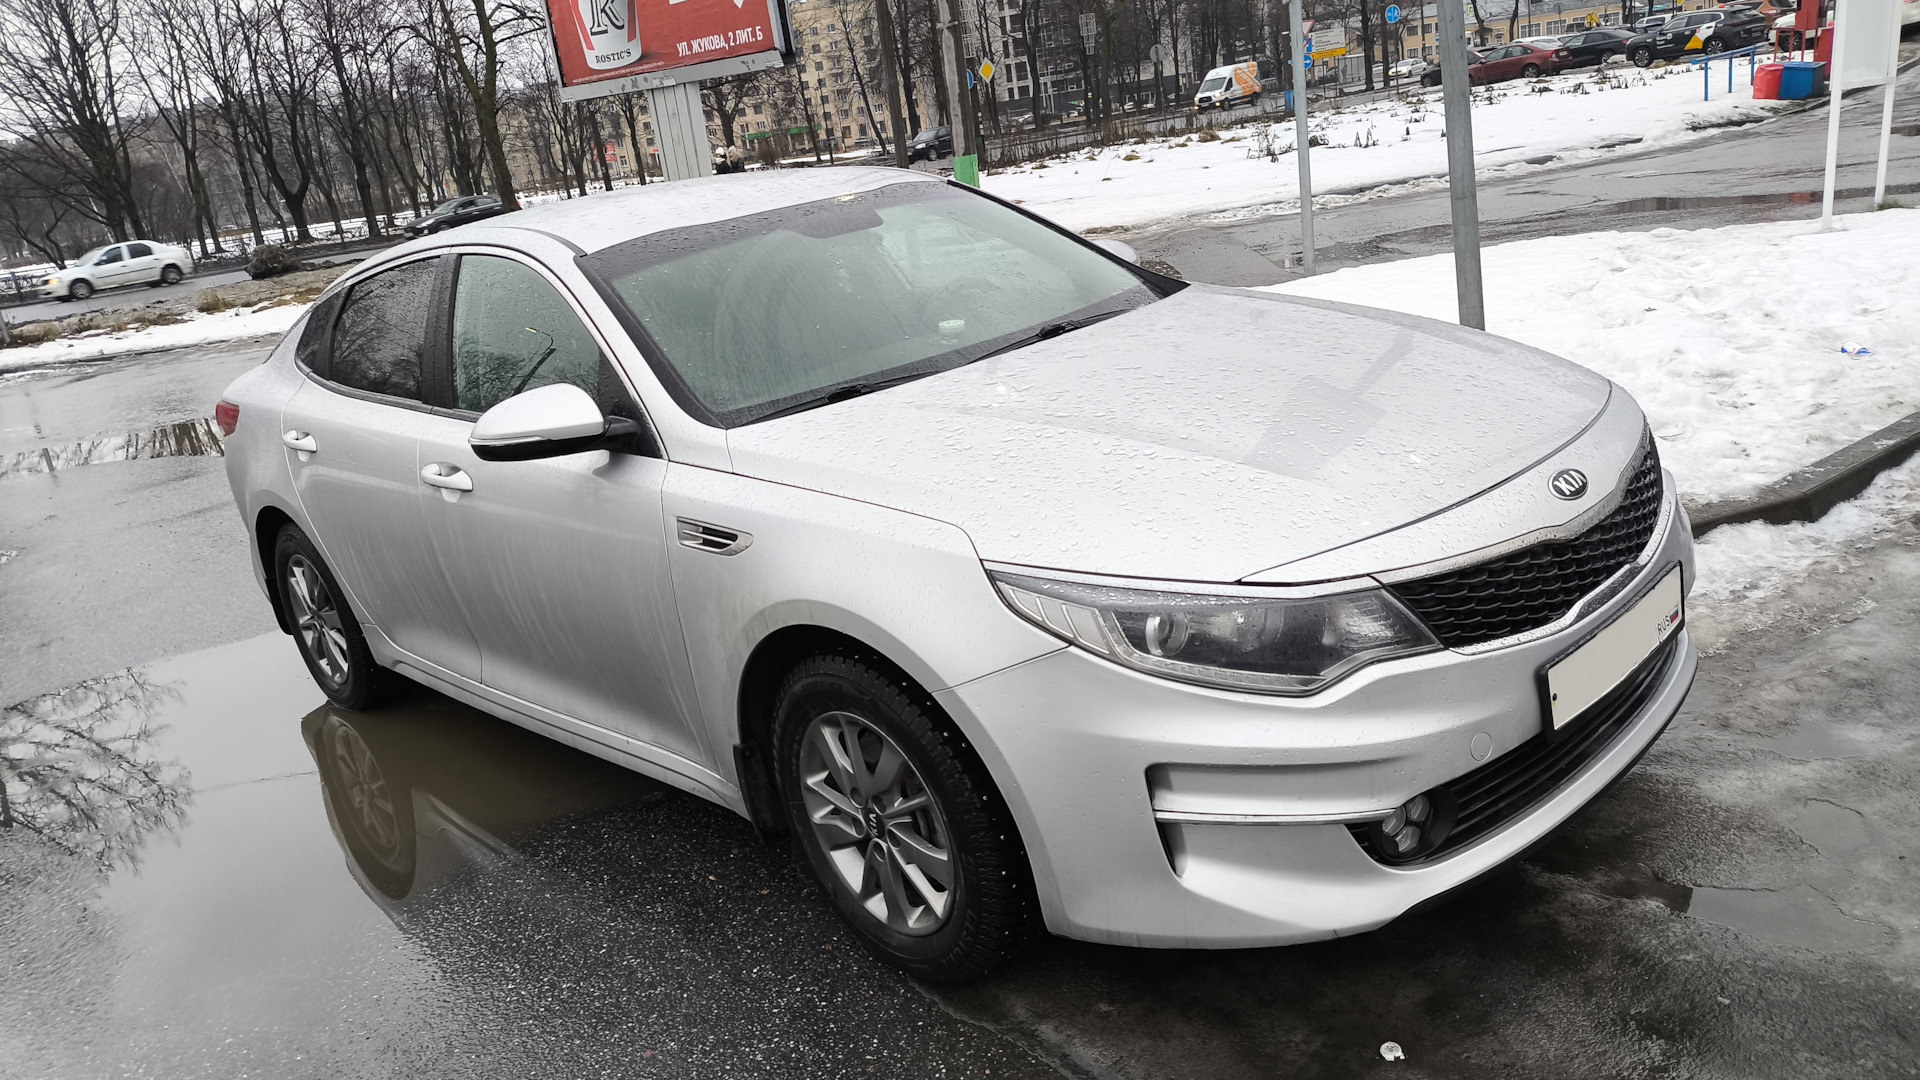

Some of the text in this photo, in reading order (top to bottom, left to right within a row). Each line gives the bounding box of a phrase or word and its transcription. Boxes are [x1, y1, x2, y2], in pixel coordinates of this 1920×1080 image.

[676, 25, 764, 57] УЛ. ЖУКОВА, 2 ЛИТ. Б
[595, 48, 632, 64] ROSTIC'S
[1553, 470, 1587, 496] KIA
[1657, 614, 1670, 636] RUS
[868, 813, 879, 836] KIA
